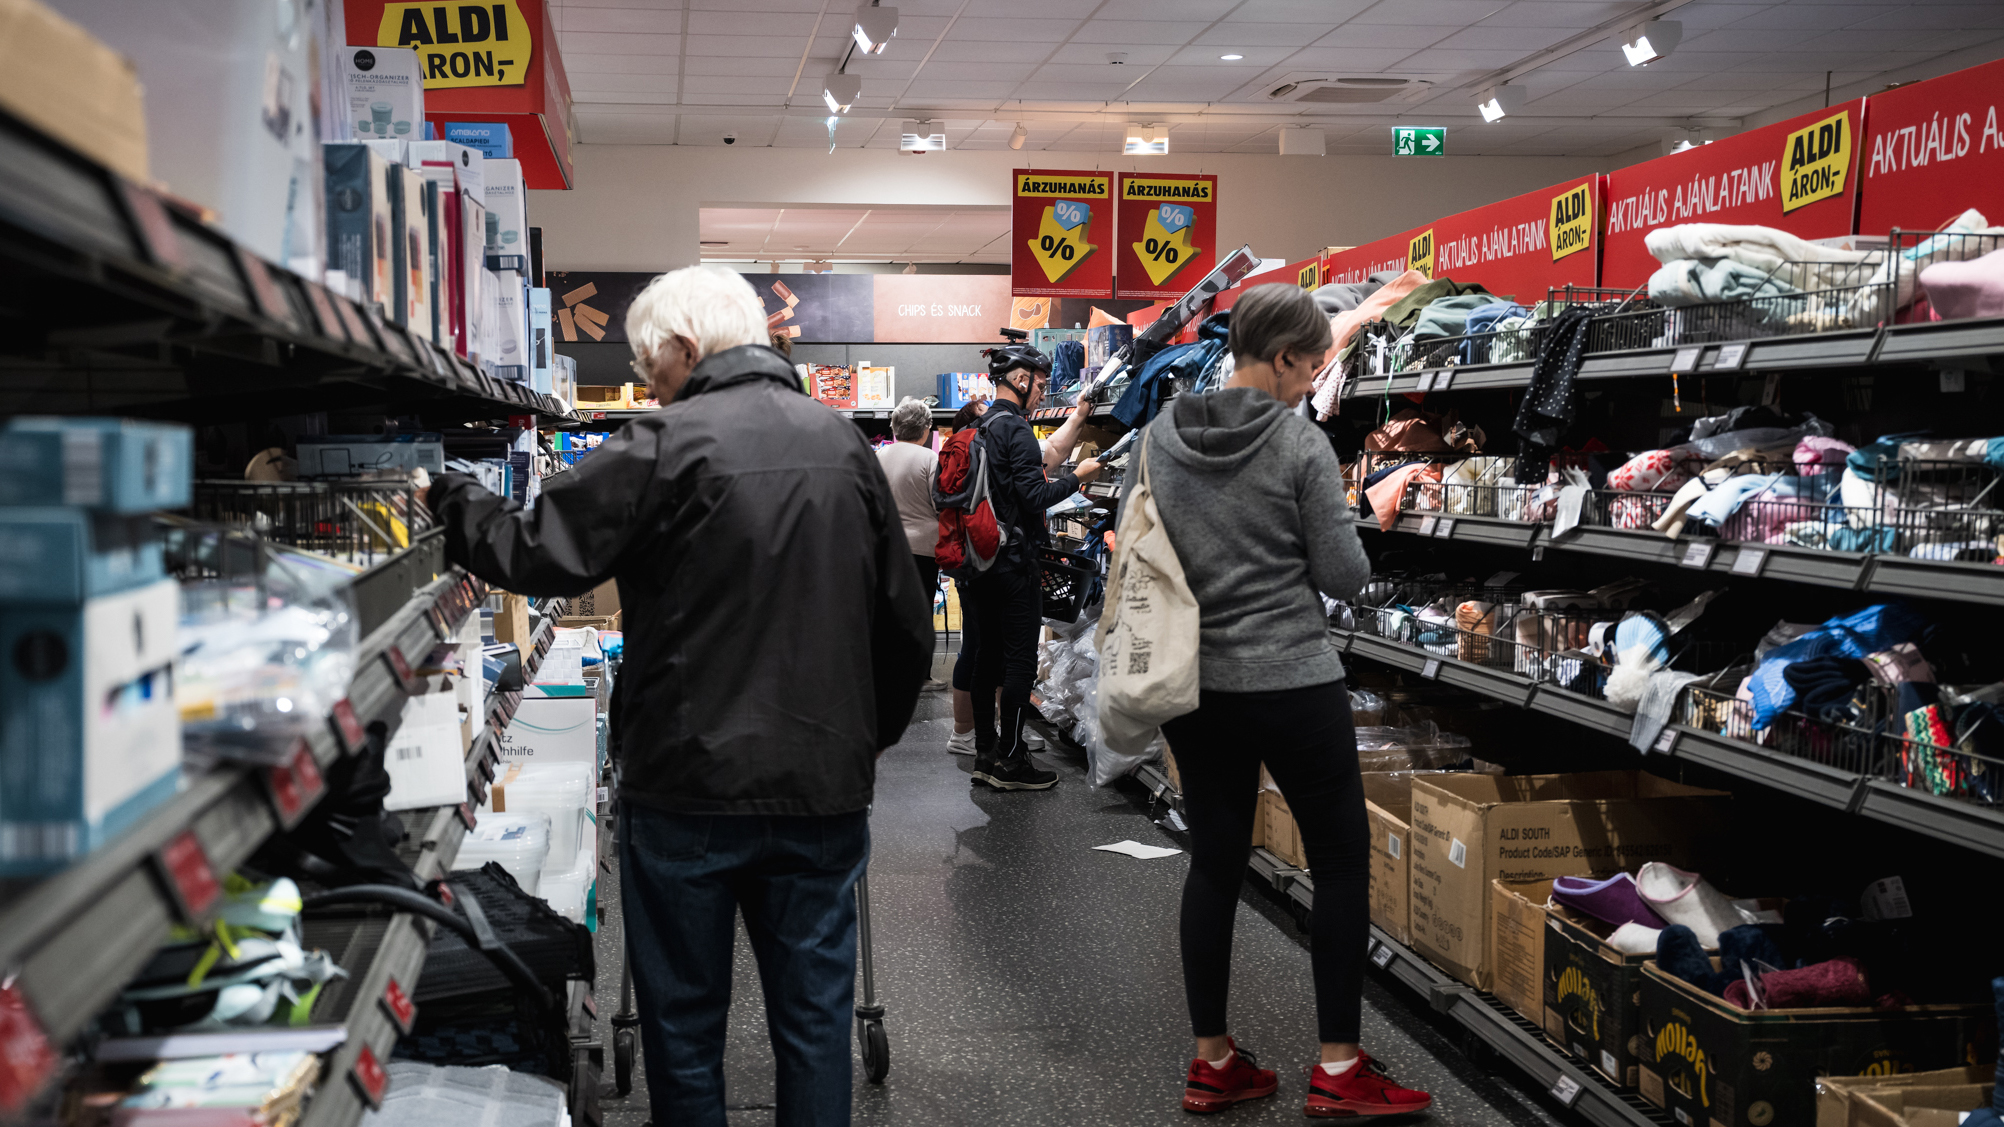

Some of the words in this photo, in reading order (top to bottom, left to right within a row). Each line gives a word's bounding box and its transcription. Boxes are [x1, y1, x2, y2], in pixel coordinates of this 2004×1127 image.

[398, 4, 508, 46] ALDI
[413, 43, 514, 82] RON,-
[1789, 118, 1843, 172] ALDI
[1869, 111, 1971, 178] AKTUÁLIS
[1021, 177, 1105, 195] ÁRZUHANÁS
[1126, 180, 1209, 198] ÁRZUHANÁS
[1608, 186, 1668, 235] AKTUÁLIS
[1672, 160, 1775, 221] AJÁNLATANK
[1788, 164, 1841, 203] ÁRON,-
[1555, 188, 1585, 228] ALDI
[1411, 233, 1431, 265] ALDI
[1438, 234, 1478, 272] AKTUÁLIS
[1481, 218, 1546, 263] AJÁNLATANK
[1556, 224, 1587, 252] ÁRON,-
[1300, 265, 1316, 289] ALDI
[898, 305, 926, 317] CHIPS
[931, 302, 943, 316] ÉS
[948, 304, 982, 317] SNACK
[1499, 846, 1530, 858] Product
[1532, 845, 1570, 858] Code/SAP
[1573, 845, 1602, 857] Generic
[1500, 828, 1519, 840] ALDI
[1522, 828, 1550, 840] SOUTH
